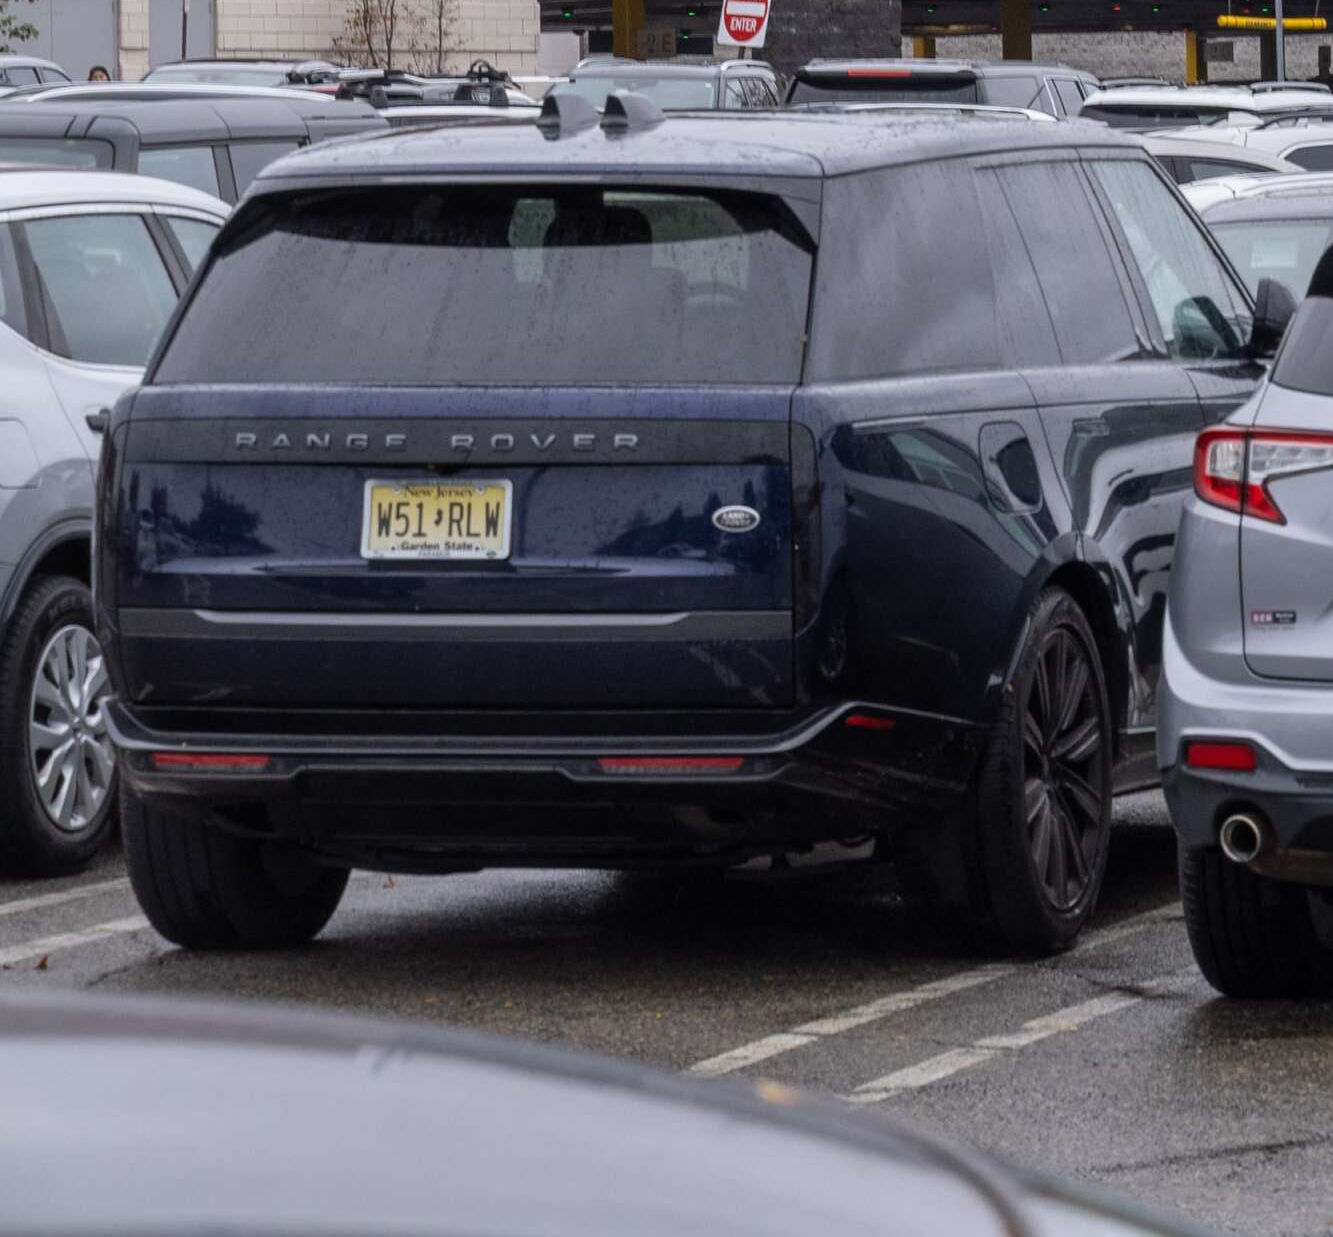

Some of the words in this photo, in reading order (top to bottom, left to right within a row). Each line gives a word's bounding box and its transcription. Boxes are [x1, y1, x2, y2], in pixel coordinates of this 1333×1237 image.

[729, 16, 757, 32] ENTER
[234, 432, 408, 450] RANGE
[450, 433, 641, 452] ROVER
[434, 485, 475, 500] Jersey
[377, 501, 428, 538] W51
[447, 501, 501, 539] RLW
[401, 541, 440, 552] Garden
[444, 541, 474, 552] State
